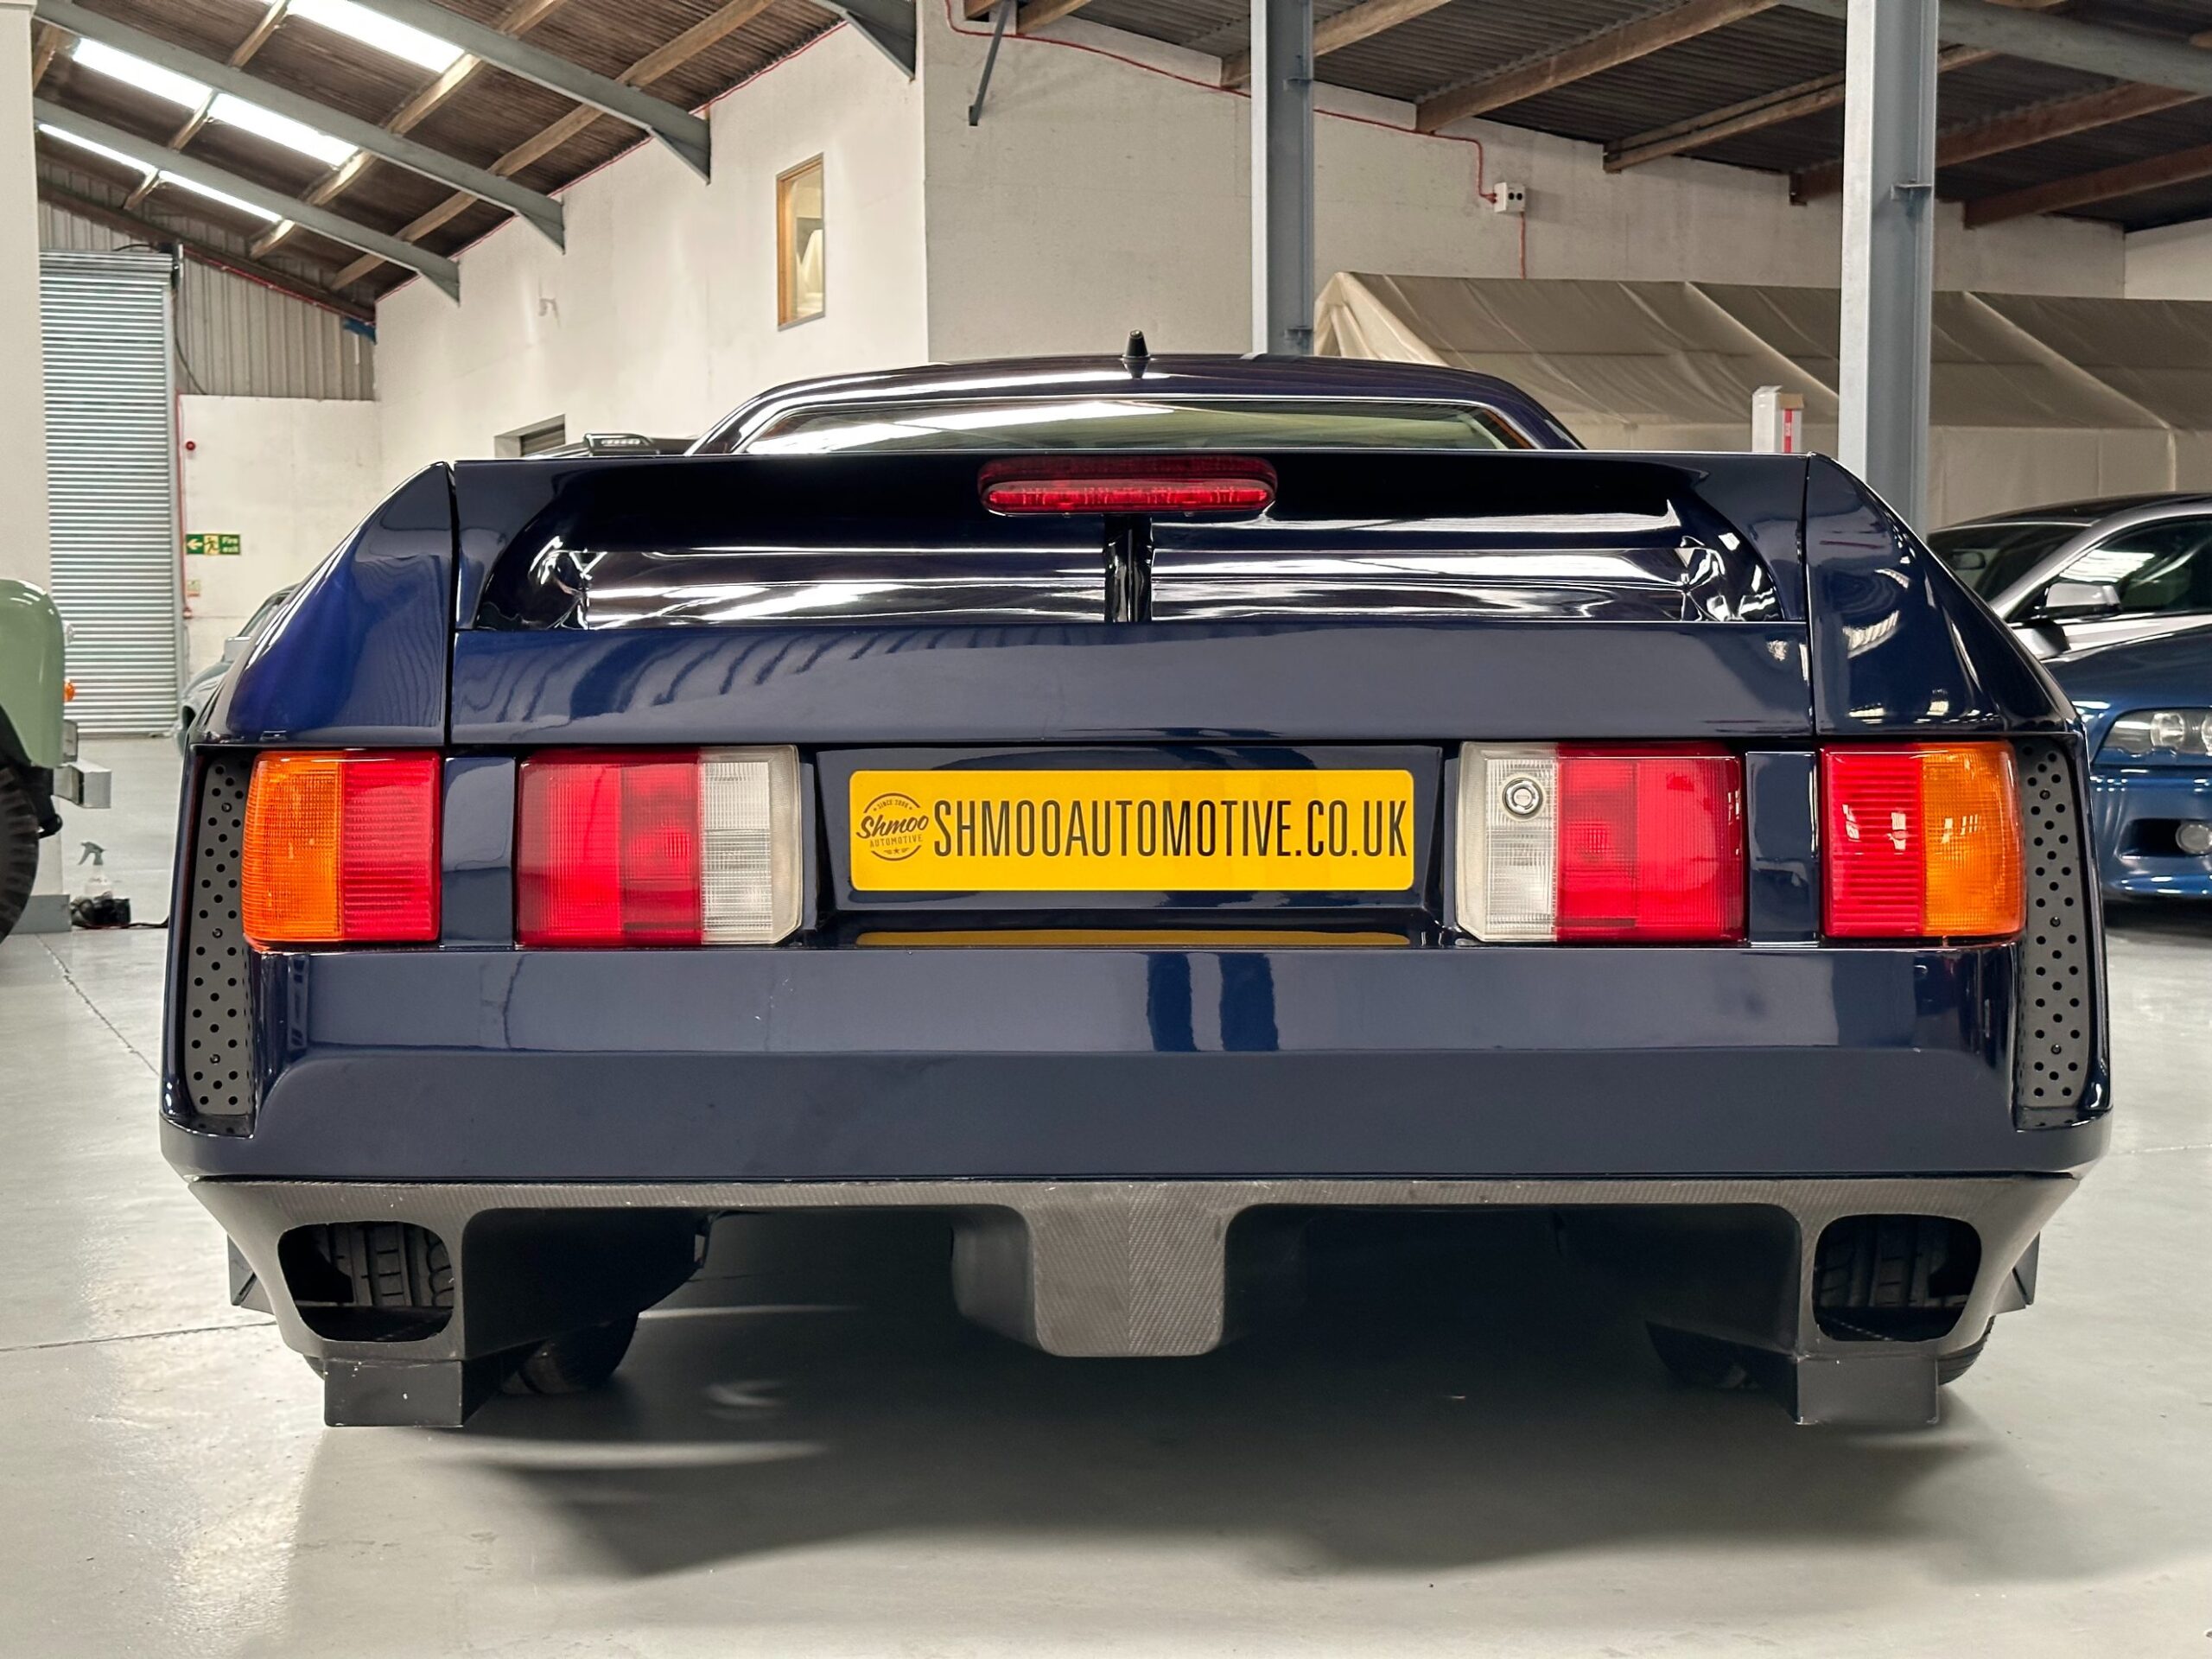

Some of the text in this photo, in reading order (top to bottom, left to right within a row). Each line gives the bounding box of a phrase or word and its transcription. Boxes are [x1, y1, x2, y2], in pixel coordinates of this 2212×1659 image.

[856, 814, 930, 839] Shmoo
[934, 800, 1407, 856] SHMOOAUTOMOTIVE.CO.UK
[869, 834, 924, 849] AUTOMOTIVE
